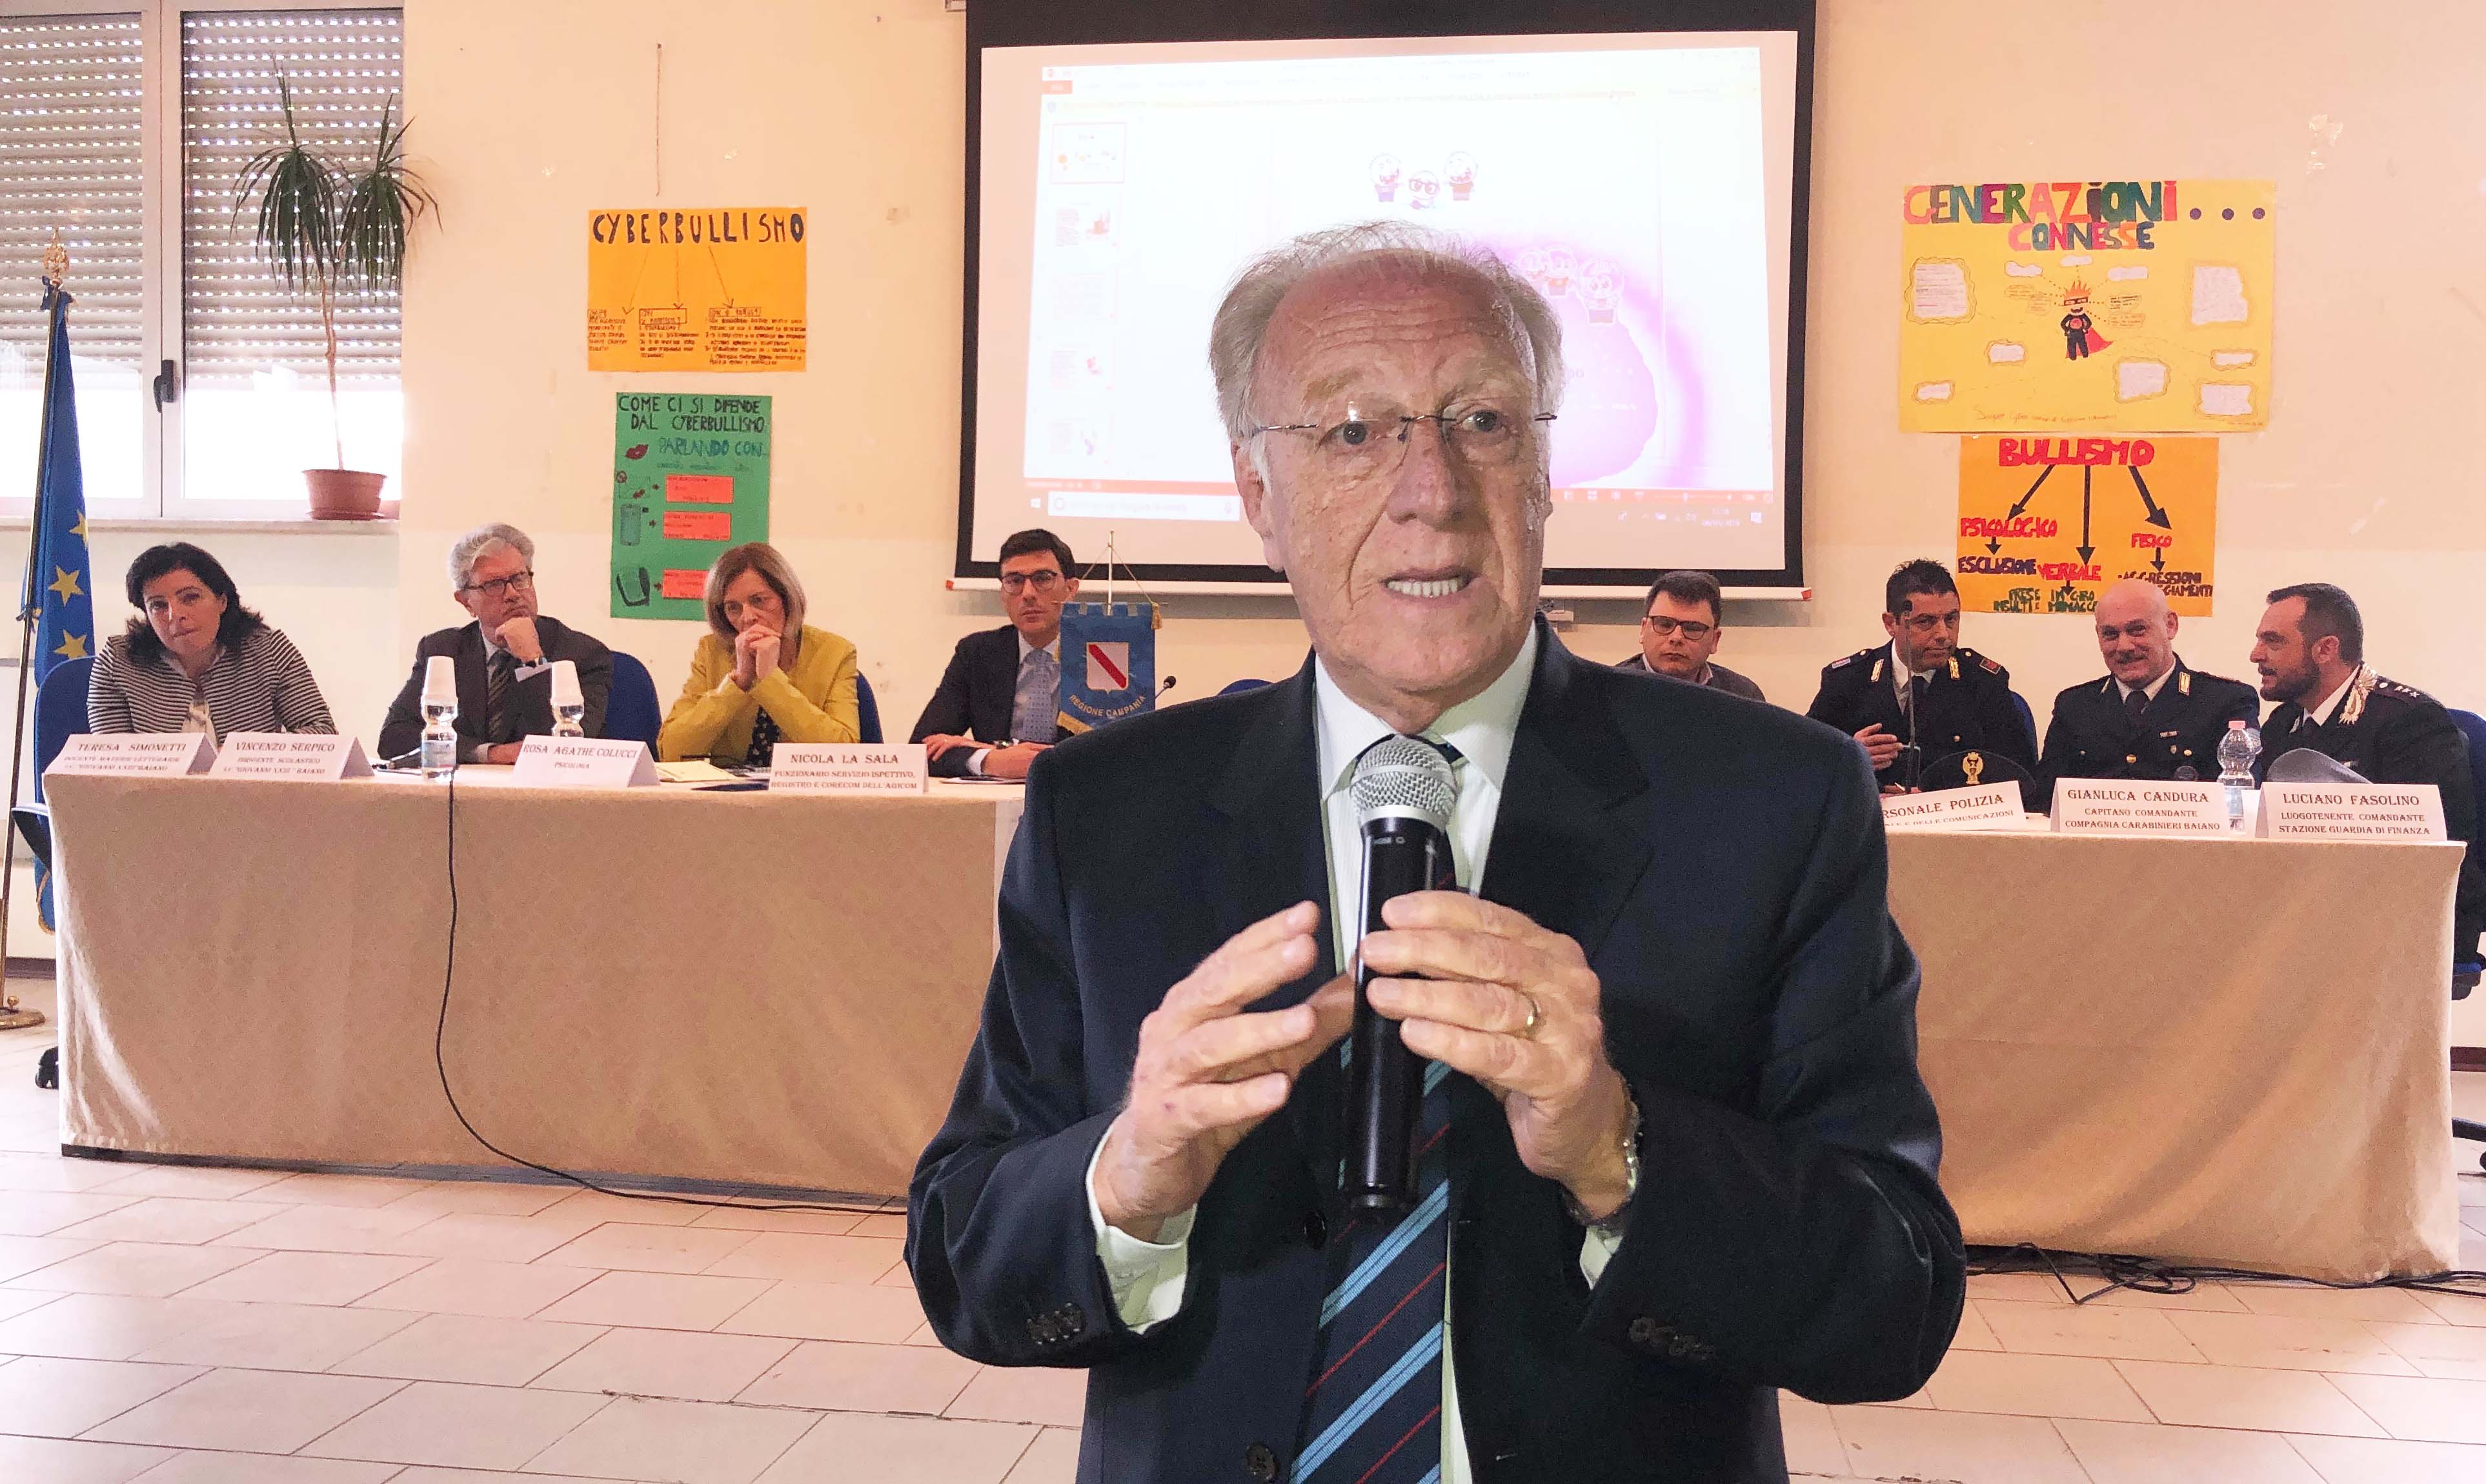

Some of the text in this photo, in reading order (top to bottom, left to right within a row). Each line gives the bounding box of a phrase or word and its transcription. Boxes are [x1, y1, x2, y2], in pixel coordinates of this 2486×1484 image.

[592, 212, 804, 244] CYBERBULLISMO
[2008, 221, 2155, 251] CONNESSE
[618, 396, 762, 414] COME CI SI DIFENDE
[631, 414, 765, 433] DAL CYBERBULLISMO
[1999, 438, 2155, 467] BULLISMO
[1961, 517, 2057, 538] PSICOLOGICO
[2131, 532, 2173, 548] FISICO
[1958, 556, 2037, 576] ESCLUSIONE
[2037, 563, 2101, 581] VERBALE
[1069, 694, 1146, 717] REGIONE CAMPANIA
[236, 743, 335, 752] VINCENZO SERPICO
[523, 744, 638, 759] ROSA AGATHE COLUCCI
[791, 754, 898, 764] NICOLA LA SALA
[2068, 789, 2209, 803] GIANLUCA CANDURA
[2283, 794, 2420, 806] LUCIANO FASOLINO
[1882, 794, 2004, 819] RSONALE POLIZIA
[2085, 808, 2131, 816] CAPITANO
[1943, 810, 2014, 823] COMUNICAZIONI
[2281, 812, 2425, 821] LUOGOTENENTE COMANDANTE
[2065, 820, 2119, 828] COMPAGNIA
[2122, 821, 2182, 830] CARABINIERI
[2387, 827, 2430, 835] FINANZA
